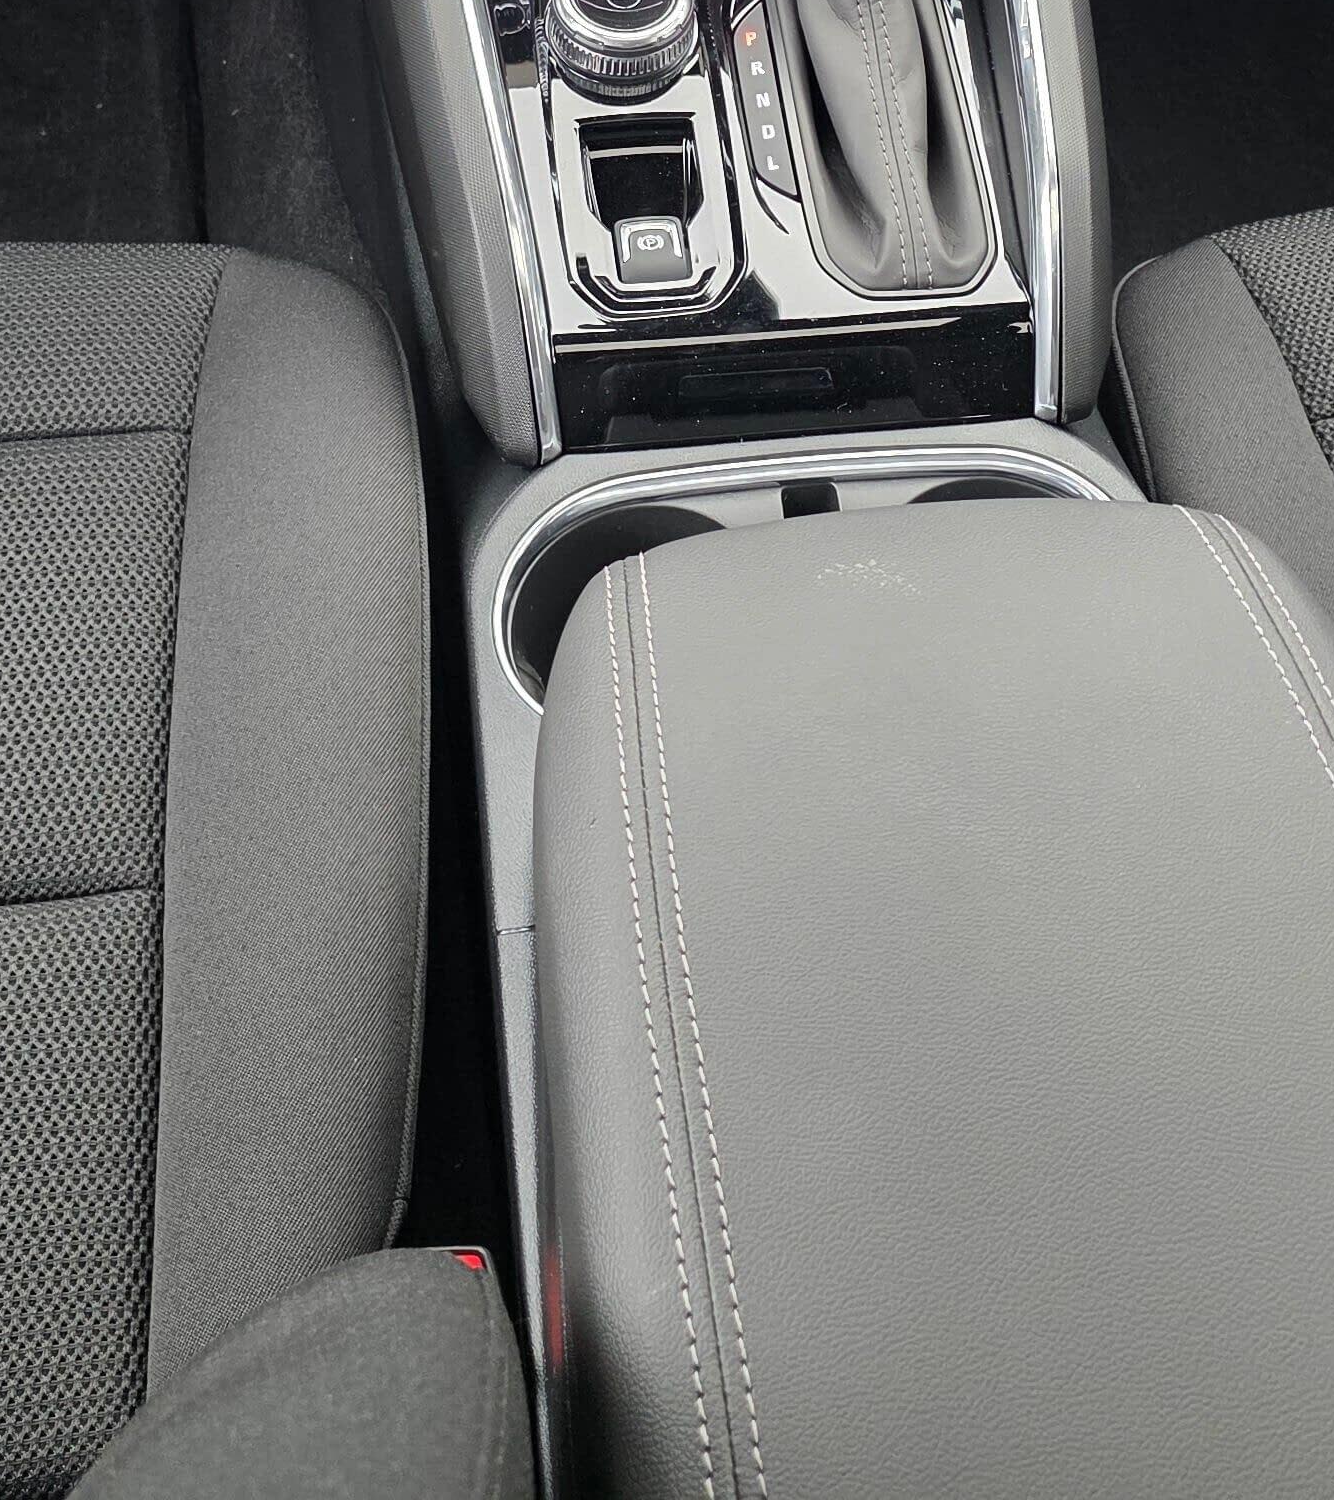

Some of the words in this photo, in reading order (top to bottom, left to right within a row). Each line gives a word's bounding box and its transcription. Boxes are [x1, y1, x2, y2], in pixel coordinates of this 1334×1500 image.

[745, 31, 757, 46] P
[751, 61, 766, 76] R
[755, 92, 771, 108] N
[761, 124, 776, 140] D
[767, 155, 779, 171] L
